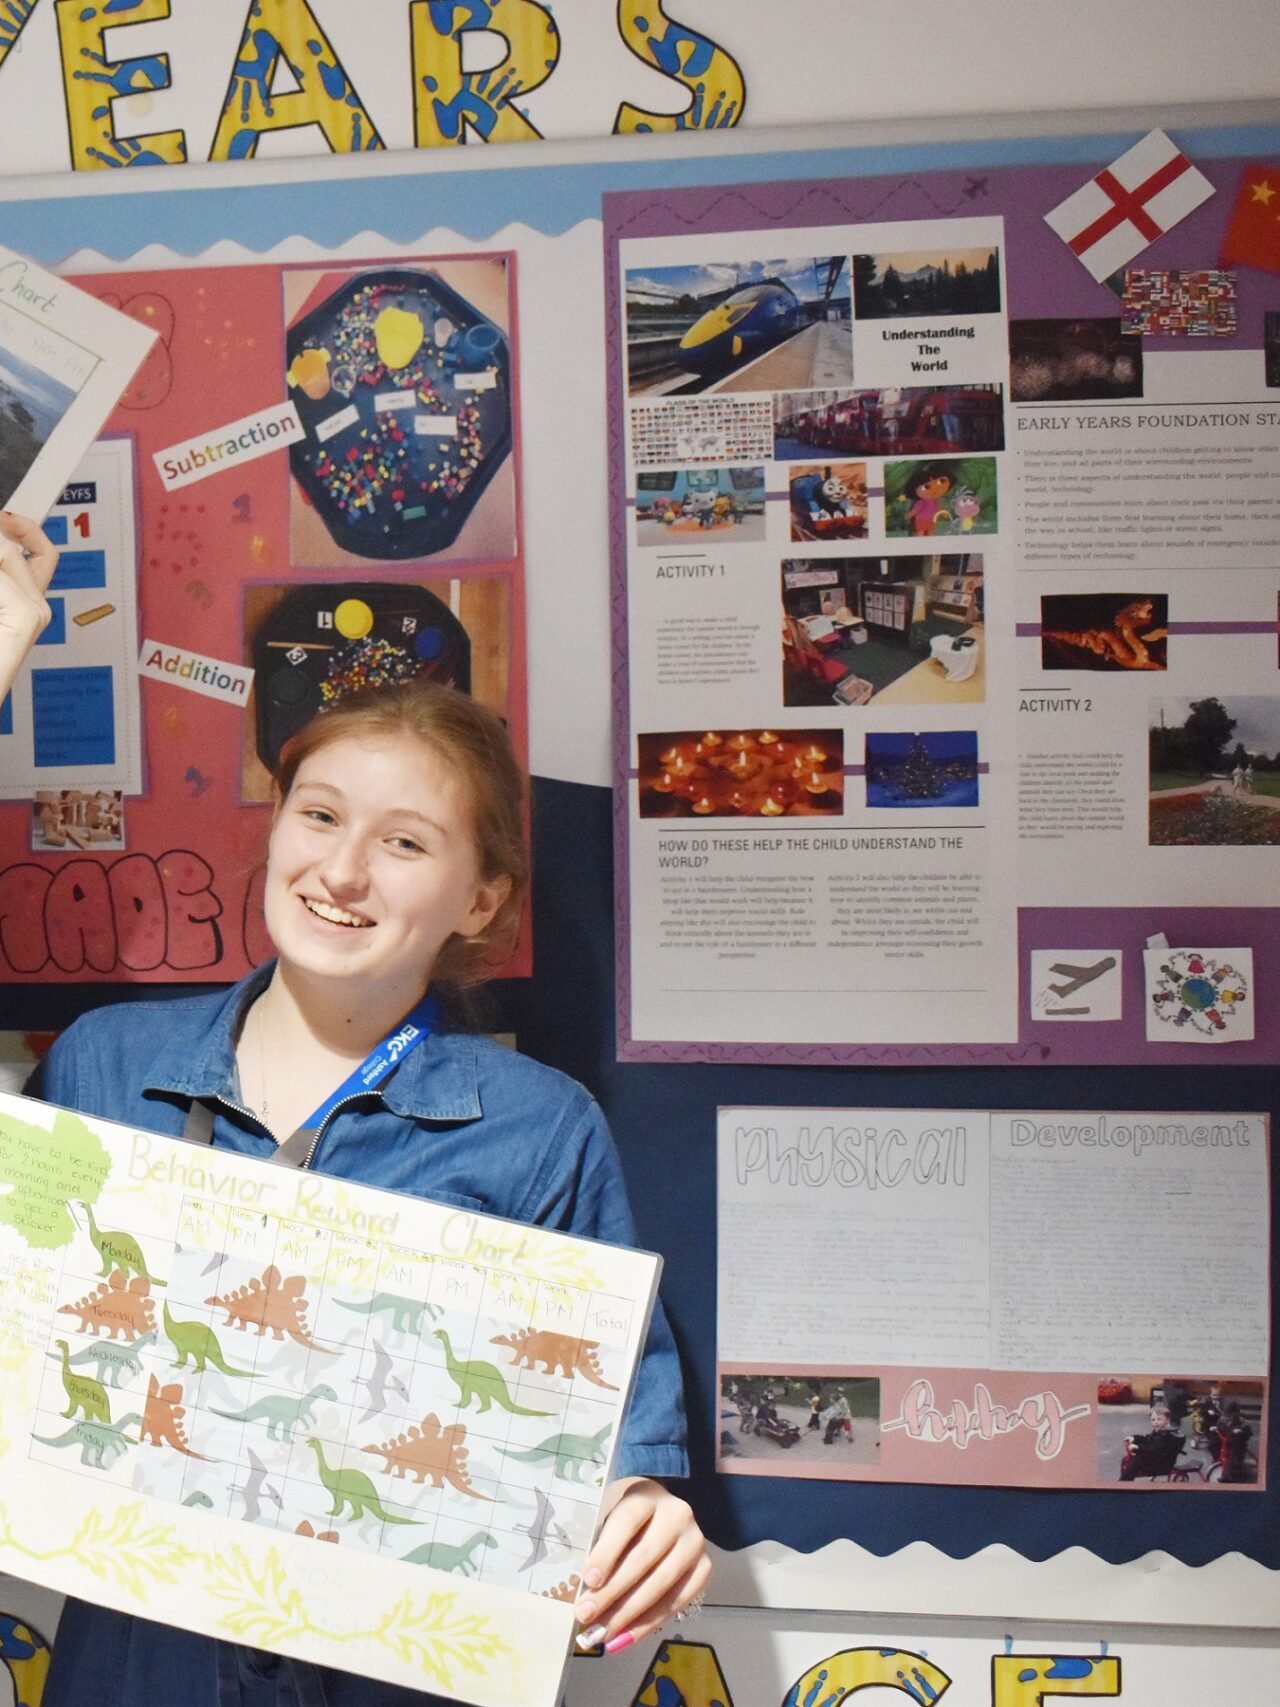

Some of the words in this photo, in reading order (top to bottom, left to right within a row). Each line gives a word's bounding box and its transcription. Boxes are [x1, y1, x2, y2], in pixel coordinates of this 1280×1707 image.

[882, 324, 976, 343] Understanding
[918, 343, 941, 357] The
[911, 359, 948, 373] World
[1017, 416, 1071, 431] EARLY
[1077, 415, 1132, 430] YEARS
[1138, 413, 1251, 429] FOUNDATION
[163, 414, 297, 480] Subtraction
[63, 486, 92, 501] EYFS
[74, 511, 91, 539] 1
[656, 565, 715, 579] ACTIVITY
[719, 564, 726, 577] 1
[145, 649, 246, 695] Addition
[1019, 699, 1081, 713] ACTIVITY
[1084, 699, 1093, 712] 2
[659, 839, 689, 852] HOW
[692, 839, 709, 851] DO
[712, 839, 750, 851] THESE
[753, 838, 783, 851] HELP
[787, 838, 810, 850] THE
[813, 838, 849, 850] CHILD
[852, 837, 937, 850] UNDERSTAND
[940, 837, 964, 849] THE
[658, 856, 709, 868] WORLD?
[387, 1024, 420, 1053] EKC
[362, 1058, 389, 1085] Ashford
[1010, 1116, 1251, 1156] Development
[21, 1153, 29, 1166] 2
[49, 1148, 62, 1159] to
[56, 1180, 81, 1194] and
[128, 1133, 278, 1202] Behavior
[292, 1177, 400, 1236] Reward
[439, 1211, 534, 1266] Chart
[182, 1218, 210, 1235] AM
[233, 1227, 258, 1246] PM
[101, 1240, 141, 1269] Monday
[282, 1240, 310, 1263] AM
[336, 1253, 364, 1269] PM
[388, 1264, 414, 1284] AM
[446, 1277, 469, 1298] PM
[495, 1291, 523, 1312] AM
[545, 1300, 574, 1320] PM
[89, 1305, 136, 1329] Tuesday
[589, 1310, 628, 1331] Total
